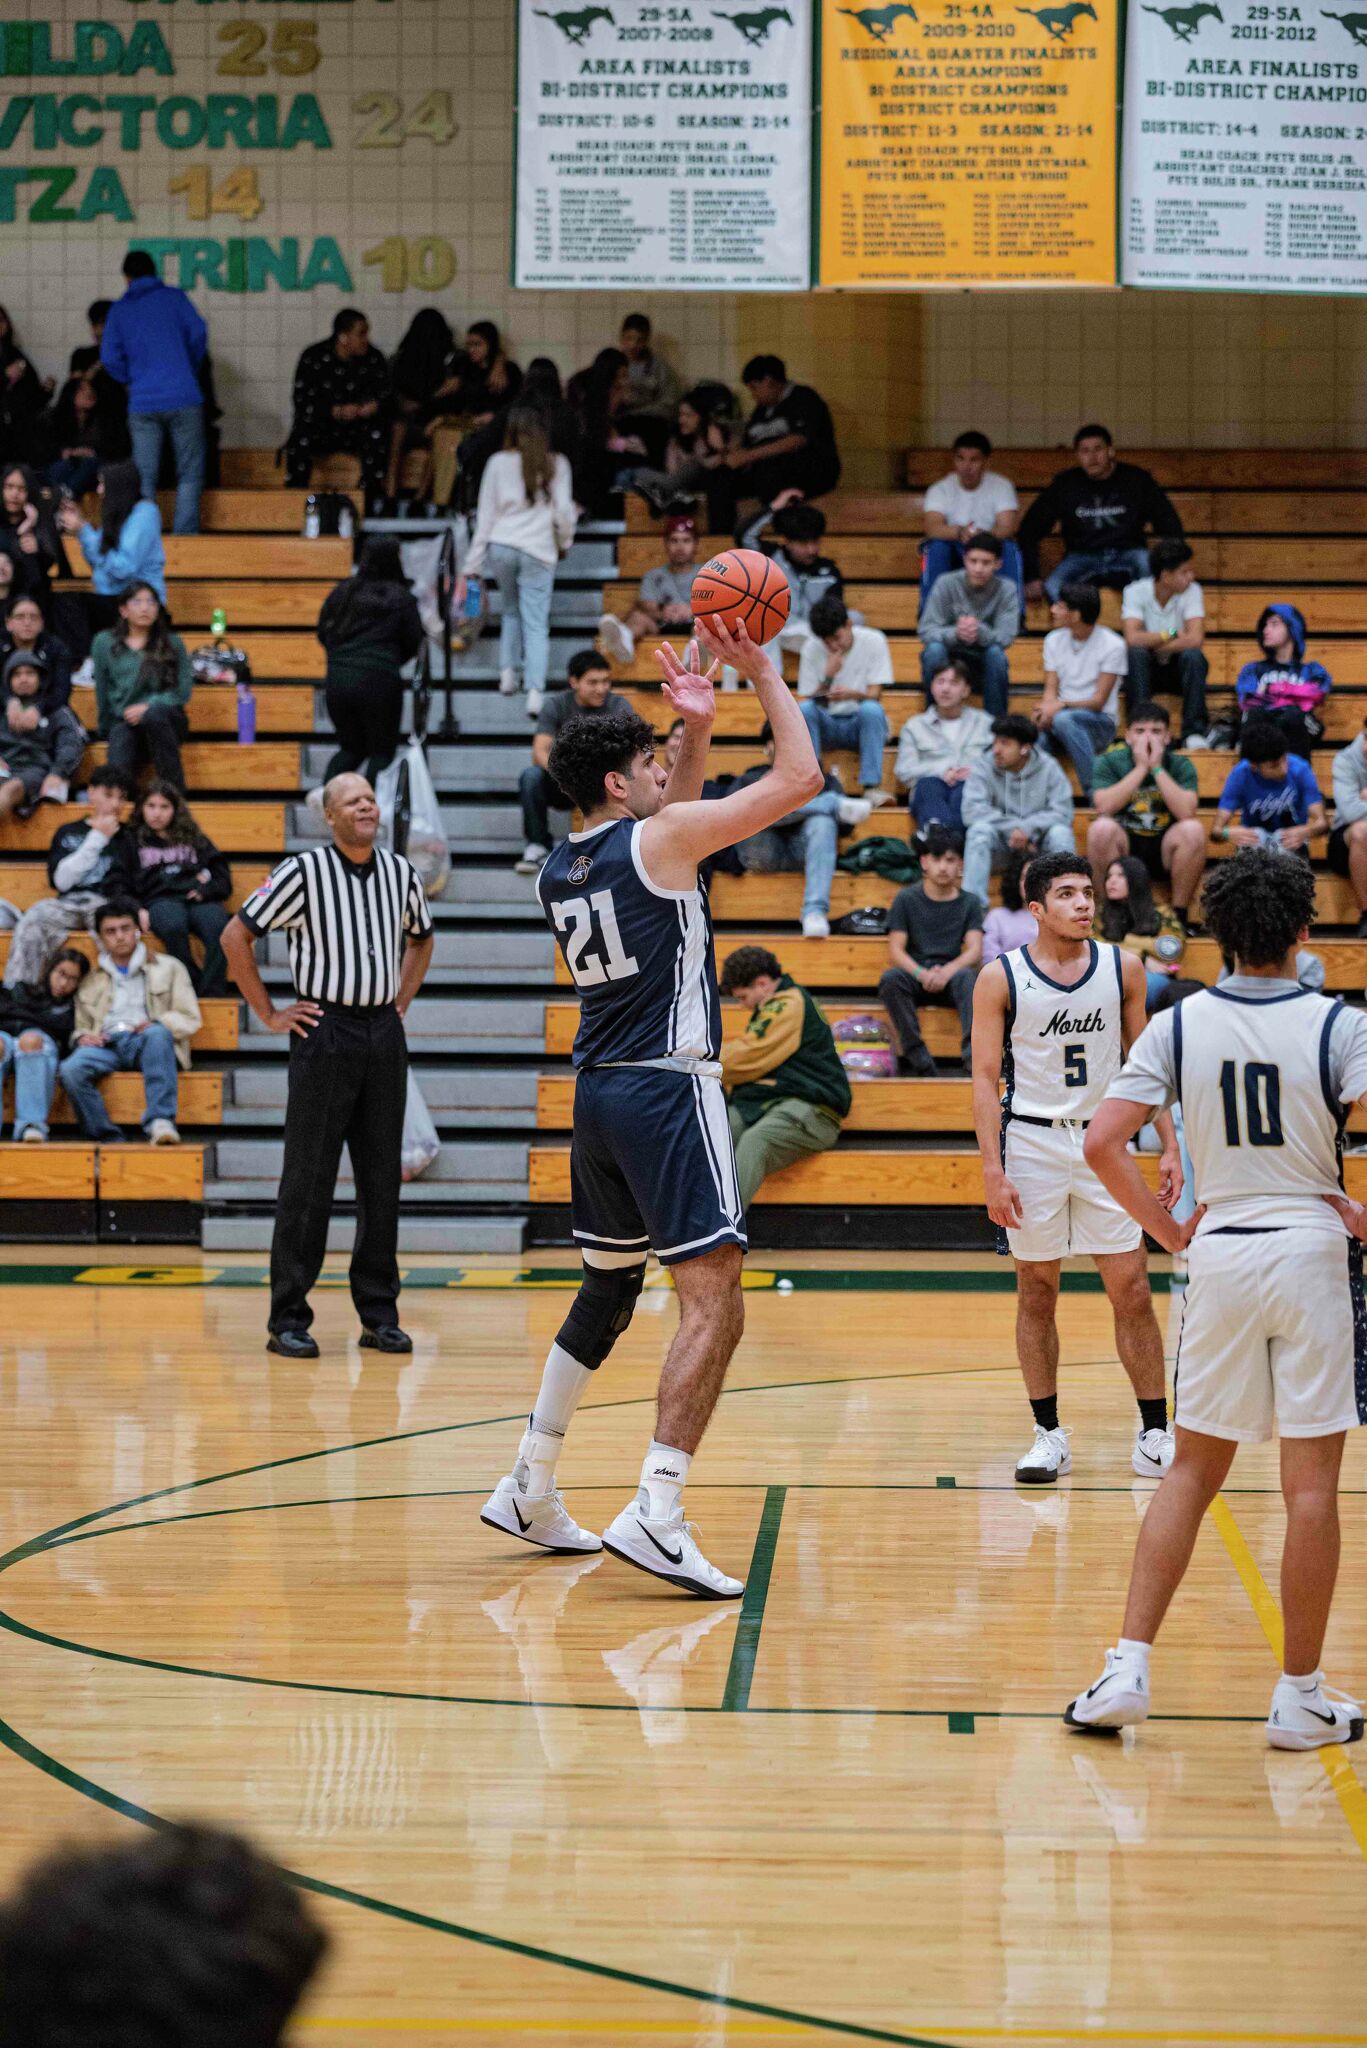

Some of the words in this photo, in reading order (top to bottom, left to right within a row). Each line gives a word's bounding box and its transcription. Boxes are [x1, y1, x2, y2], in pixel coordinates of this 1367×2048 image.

[638, 6, 694, 22] 29-5A
[1247, 4, 1302, 22] 29-5A
[617, 26, 715, 42] 2007-2008
[923, 23, 1016, 37] 2009-2010
[1231, 24, 1317, 42] 2011-2012
[0, 20, 175, 76] ILDA
[215, 20, 322, 76] 25
[841, 47, 922, 60] REGIONAL
[927, 47, 1006, 60] QUARTER
[1010, 46, 1098, 60] FINALISTS
[579, 58, 637, 74] AREA
[643, 58, 752, 75] FINALISTS
[894, 65, 941, 79] AREA
[945, 64, 1045, 78] CHAMPIONS
[1186, 57, 1244, 76] AREA
[1249, 59, 1360, 79] FINALISTS
[540, 81, 662, 98] BI-DISTRICT
[667, 82, 789, 98] CHAMPIONS
[868, 83, 967, 97] BI-DISTRICT
[970, 83, 1069, 96] CHAMPIONS
[1147, 79, 1269, 100] BI-DISTRICT
[879, 102, 955, 116] DISTRICT
[959, 102, 1059, 115] CHAMPIONS
[351, 89, 459, 149] 24
[752, 115, 791, 128] 21-14
[1141, 119, 1221, 135] DISTRICT:
[1226, 123, 1259, 136] 14-4
[1280, 124, 1351, 140] SEASON:
[1355, 126, 1367, 140] 2
[168, 164, 263, 221] 14
[361, 234, 457, 292] 10
[550, 888, 640, 987] 21
[1039, 1007, 1106, 1037] North
[1064, 1043, 1088, 1088] 5
[1219, 1060, 1285, 1147] 10
[653, 1466, 680, 1478] ZAMST
